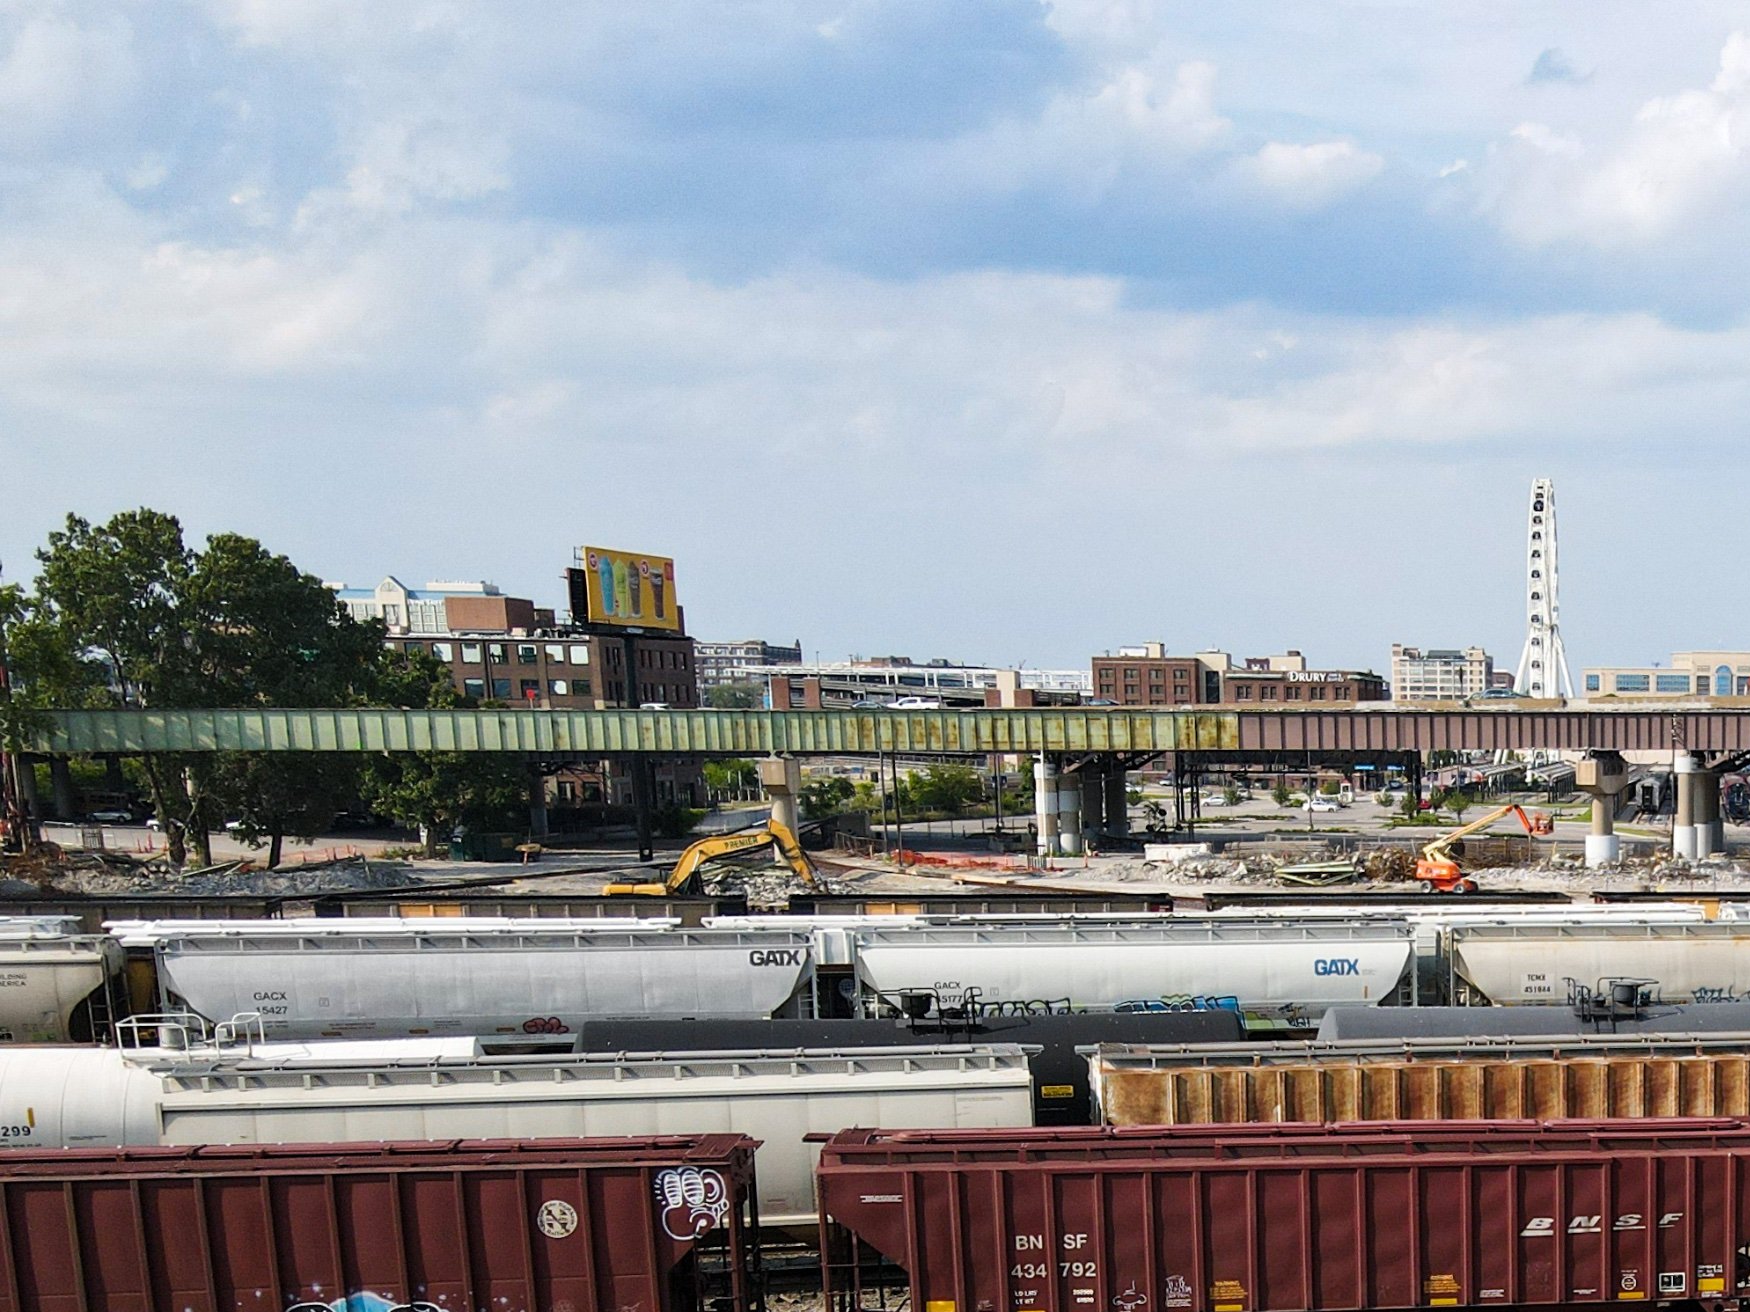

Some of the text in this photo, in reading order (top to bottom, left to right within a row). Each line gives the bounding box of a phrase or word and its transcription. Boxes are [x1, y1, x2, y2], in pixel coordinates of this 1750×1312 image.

[1288, 671, 1327, 682] DRURY
[749, 949, 800, 967] GATX
[1314, 958, 1359, 977] GATX
[934, 981, 961, 990] GACX
[253, 991, 287, 1001] GACX
[255, 1006, 288, 1016] 15427
[1015, 1233, 1088, 1250] BN SF
[1011, 1261, 1097, 1279] 434 792
